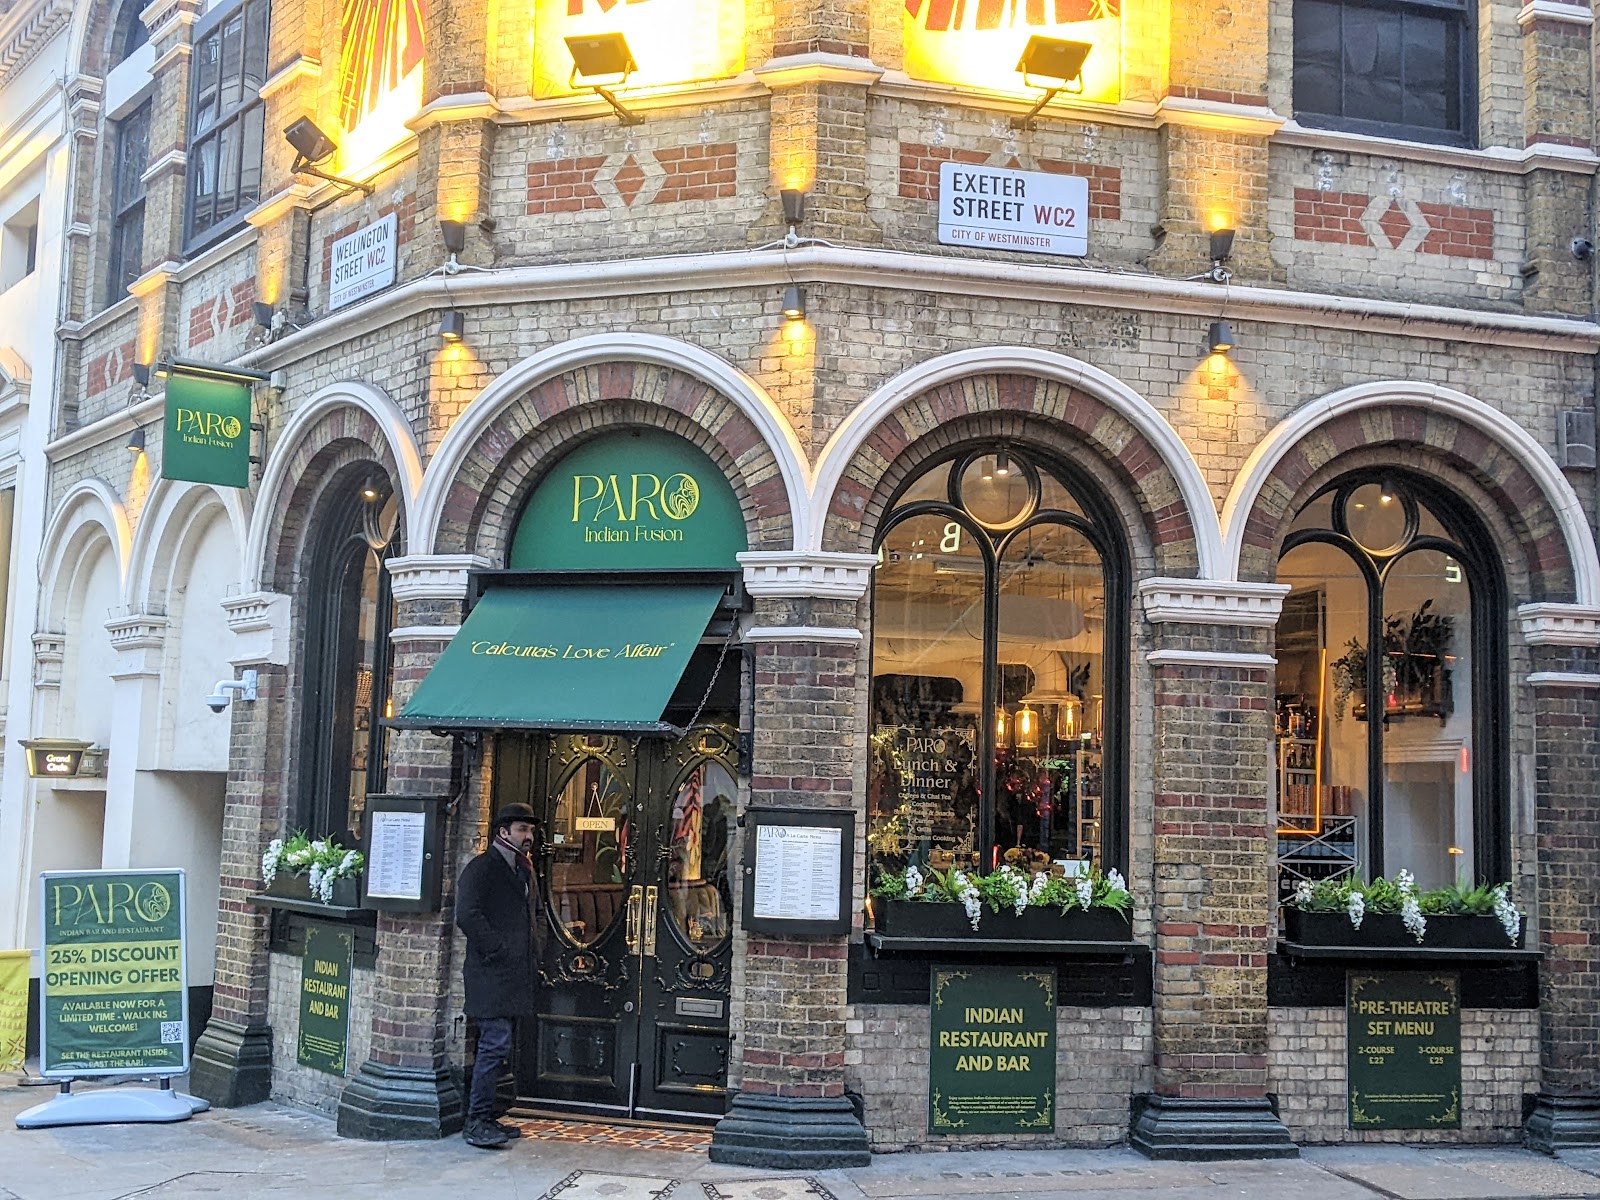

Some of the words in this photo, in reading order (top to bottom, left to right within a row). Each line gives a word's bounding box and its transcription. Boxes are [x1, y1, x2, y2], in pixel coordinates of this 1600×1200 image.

[953, 172, 1026, 198] EXETER
[953, 196, 1025, 222] STREET
[1033, 204, 1075, 228] WC2
[336, 222, 389, 263] WELLINGTON
[951, 228, 971, 241] CITY
[974, 231, 986, 241] OF
[988, 232, 1051, 248] WESTMINSTER
[334, 255, 364, 284] STREET
[367, 245, 386, 269] WC2
[333, 294, 342, 304] CITY
[342, 292, 348, 300] OF
[348, 279, 375, 298] WESTMINSTER
[176, 408, 241, 439] PARO
[183, 433, 207, 445] Indian
[208, 436, 234, 449] Fusion
[571, 472, 700, 522] PARO
[584, 526, 629, 543] Indian
[634, 525, 684, 542] Fusion
[562, 644, 611, 659] Love
[906, 736, 946, 754] PARO
[46, 754, 71, 763] Grand
[893, 759, 939, 772] Lunch
[944, 759, 958, 773] &
[46, 763, 68, 772] Circle
[900, 775, 951, 789] Dinner
[582, 820, 608, 828] OPEN
[759, 826, 786, 838] PARO
[53, 882, 171, 926] PARO
[118, 926, 164, 934] RESTAURANT
[50, 949, 86, 964] 25%
[91, 946, 179, 963] DISCOUNT
[314, 959, 338, 977] INDIAN
[46, 970, 123, 987] OPENING
[128, 968, 180, 984] OFFER
[304, 978, 348, 1000] RESTAURANT
[62, 1001, 110, 1011] AVAILABLE
[112, 1000, 136, 1009] NOW
[138, 999, 156, 1008] FOR
[158, 998, 166, 1007] A
[308, 1000, 324, 1016] AND
[324, 1003, 338, 1019] BAR
[1359, 1000, 1449, 1015] PRE-THEATRE
[59, 1013, 94, 1022] LIMITED
[95, 1012, 116, 1021] TIME
[122, 1011, 151, 1020] WALK
[152, 1010, 168, 1019] INS
[965, 1007, 1024, 1024] INDIAN
[89, 1023, 138, 1033] WELCOME!
[1367, 1021, 1392, 1036] SET
[1394, 1021, 1435, 1036] MENU
[939, 1031, 1049, 1048] RESTAURANT
[61, 1052, 74, 1060] SEE
[76, 1051, 90, 1059] THE
[91, 1050, 142, 1058] RESTAURANT
[142, 1048, 168, 1056] INSIDE
[1358, 1046, 1395, 1054] 2-COURSE
[1418, 1046, 1454, 1054] 3-COURSE
[955, 1055, 993, 1072] AND
[997, 1055, 1031, 1072] BAR
[1369, 1056, 1385, 1065] £22
[1429, 1056, 1444, 1065] £25
